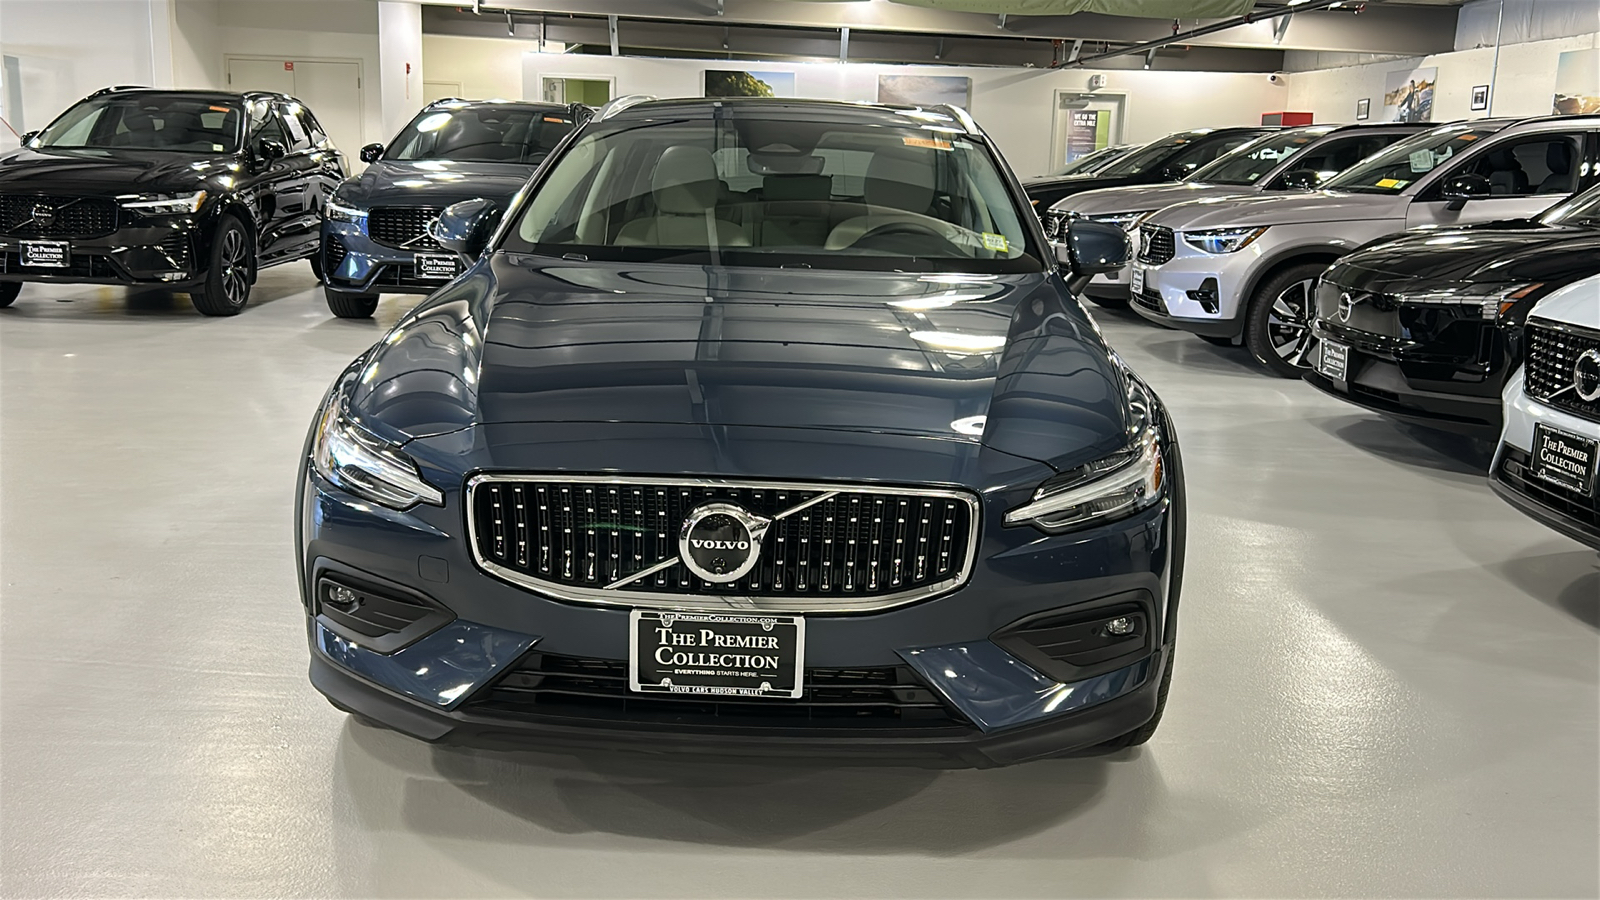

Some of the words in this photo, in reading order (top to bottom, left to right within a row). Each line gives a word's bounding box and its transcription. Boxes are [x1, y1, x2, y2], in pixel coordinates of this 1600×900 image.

[1543, 435, 1558, 452] THE
[1557, 440, 1589, 463] PREMIER
[1540, 448, 1587, 476] COLLECTION
[690, 539, 749, 550] VOLVO
[655, 627, 697, 647] THE
[699, 629, 780, 649] PREMIER
[654, 646, 780, 669] COLLECTION
[674, 668, 716, 677] EVERYTHING
[669, 685, 690, 693] VOLVO
[692, 686, 709, 694] CARS
